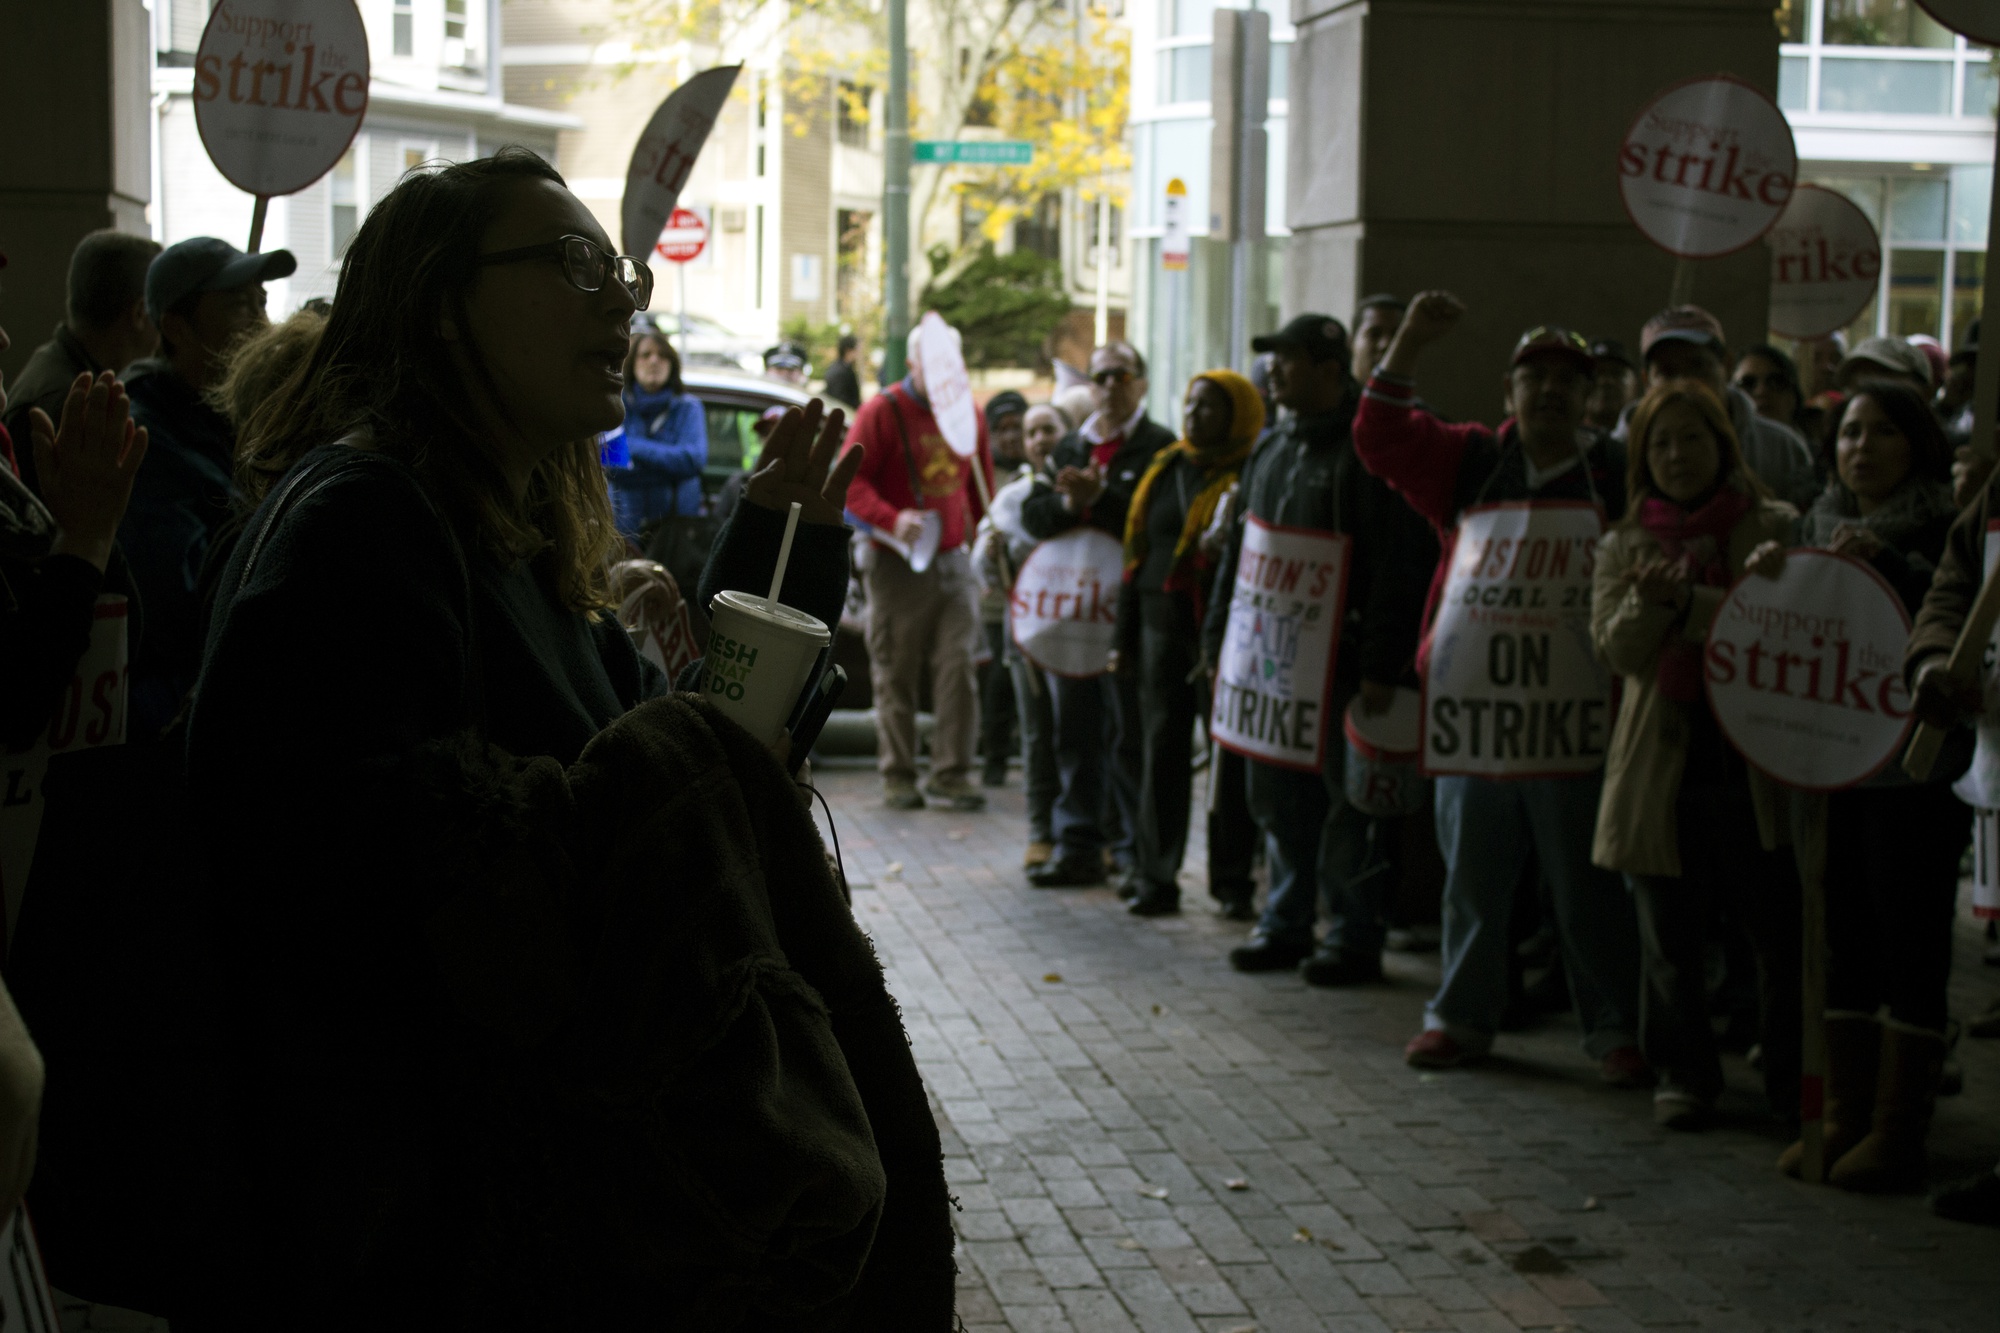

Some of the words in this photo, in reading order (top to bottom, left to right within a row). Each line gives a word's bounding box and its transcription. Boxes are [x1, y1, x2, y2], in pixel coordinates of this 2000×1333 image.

[217, 3, 314, 47] Support
[197, 41, 366, 117] strike
[1618, 142, 1796, 207] strike
[1450, 586, 1547, 608] OCAL
[1729, 591, 1846, 640] Support
[707, 656, 752, 682] WHAT
[711, 674, 745, 701] DO
[1488, 632, 1549, 688] ON
[1708, 634, 1915, 719] strike
[1214, 680, 1318, 751] STRIKE
[1432, 697, 1604, 758] STRIKE
